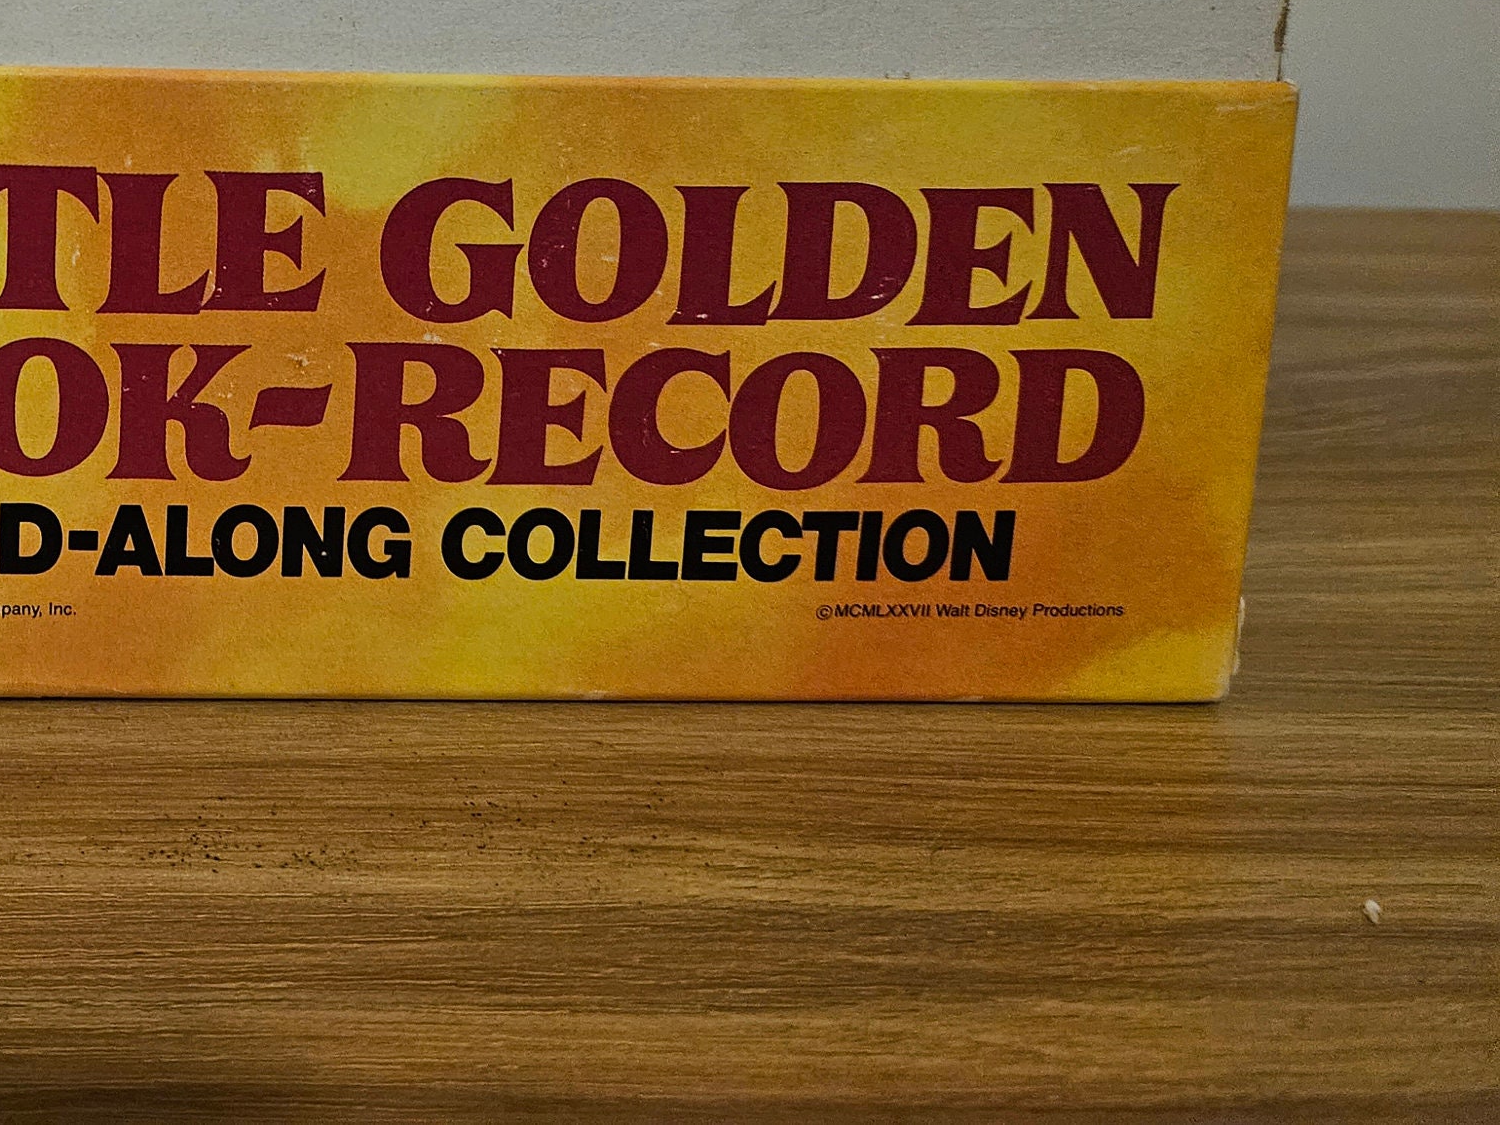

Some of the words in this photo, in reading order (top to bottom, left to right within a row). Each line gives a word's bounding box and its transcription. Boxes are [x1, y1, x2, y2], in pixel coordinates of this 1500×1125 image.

[379, 177, 1181, 326] GOLDEN
[440, 505, 1016, 583] COLLECTION
[48, 602, 78, 617] Inc.
[935, 603, 970, 618] Walt
[974, 603, 1028, 620] Disney
[1032, 603, 1125, 618] Productions
